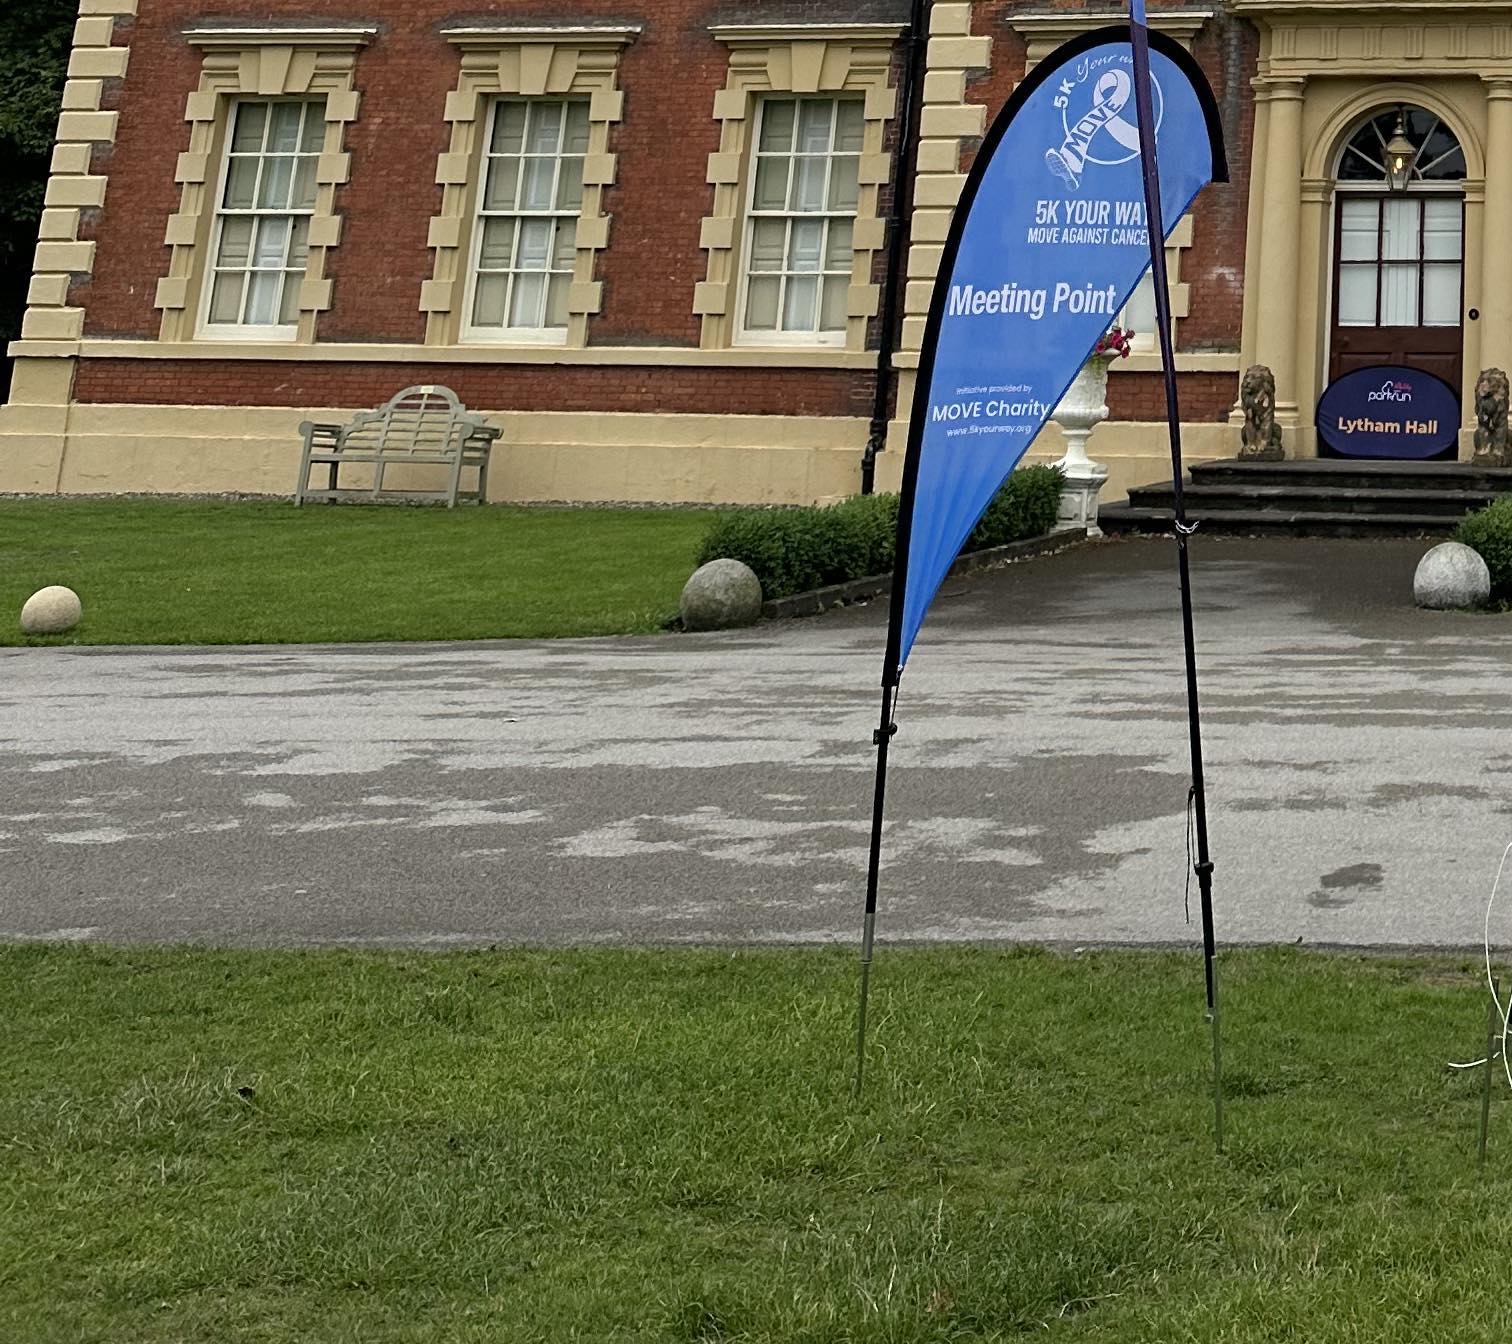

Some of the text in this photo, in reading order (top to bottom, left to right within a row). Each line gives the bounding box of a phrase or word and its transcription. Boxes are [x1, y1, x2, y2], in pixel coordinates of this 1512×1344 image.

[1053, 78, 1076, 109] 5K
[1064, 99, 1122, 162] MOVE
[1035, 199, 1060, 225] 5K
[1064, 200, 1110, 225] YOUR
[1027, 227, 1060, 244] MOVE
[1062, 228, 1109, 245] AGAINST
[949, 283, 1117, 320] Meeting Point
[1023, 384, 1033, 394] by
[1367, 380, 1411, 402] parkrun
[932, 399, 1051, 422] MOVE Charity
[1338, 416, 1437, 435] Lytham Hall
